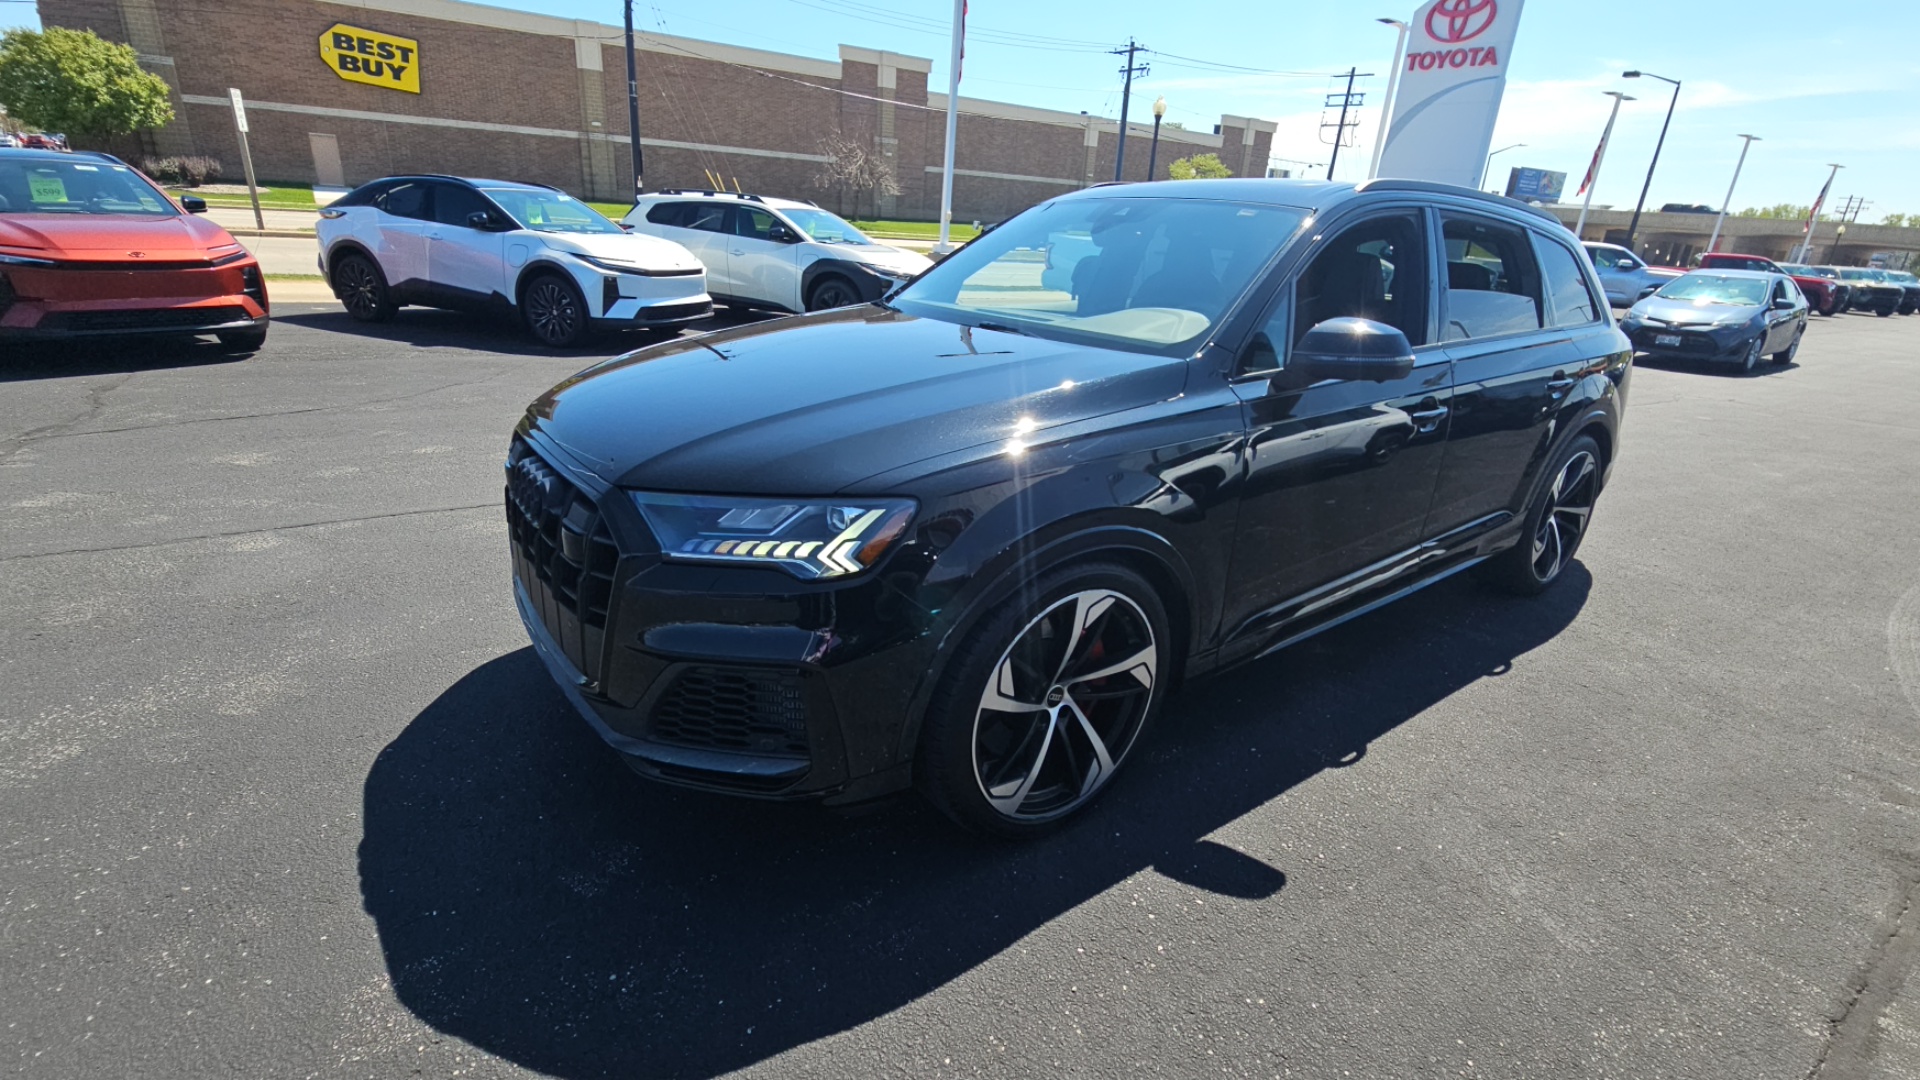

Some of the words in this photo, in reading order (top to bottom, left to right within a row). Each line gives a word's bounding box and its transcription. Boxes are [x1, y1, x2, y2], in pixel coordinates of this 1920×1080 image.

[332, 32, 414, 64] BEST
[1407, 46, 1498, 71] TOYOTA
[338, 53, 408, 81] BUY
